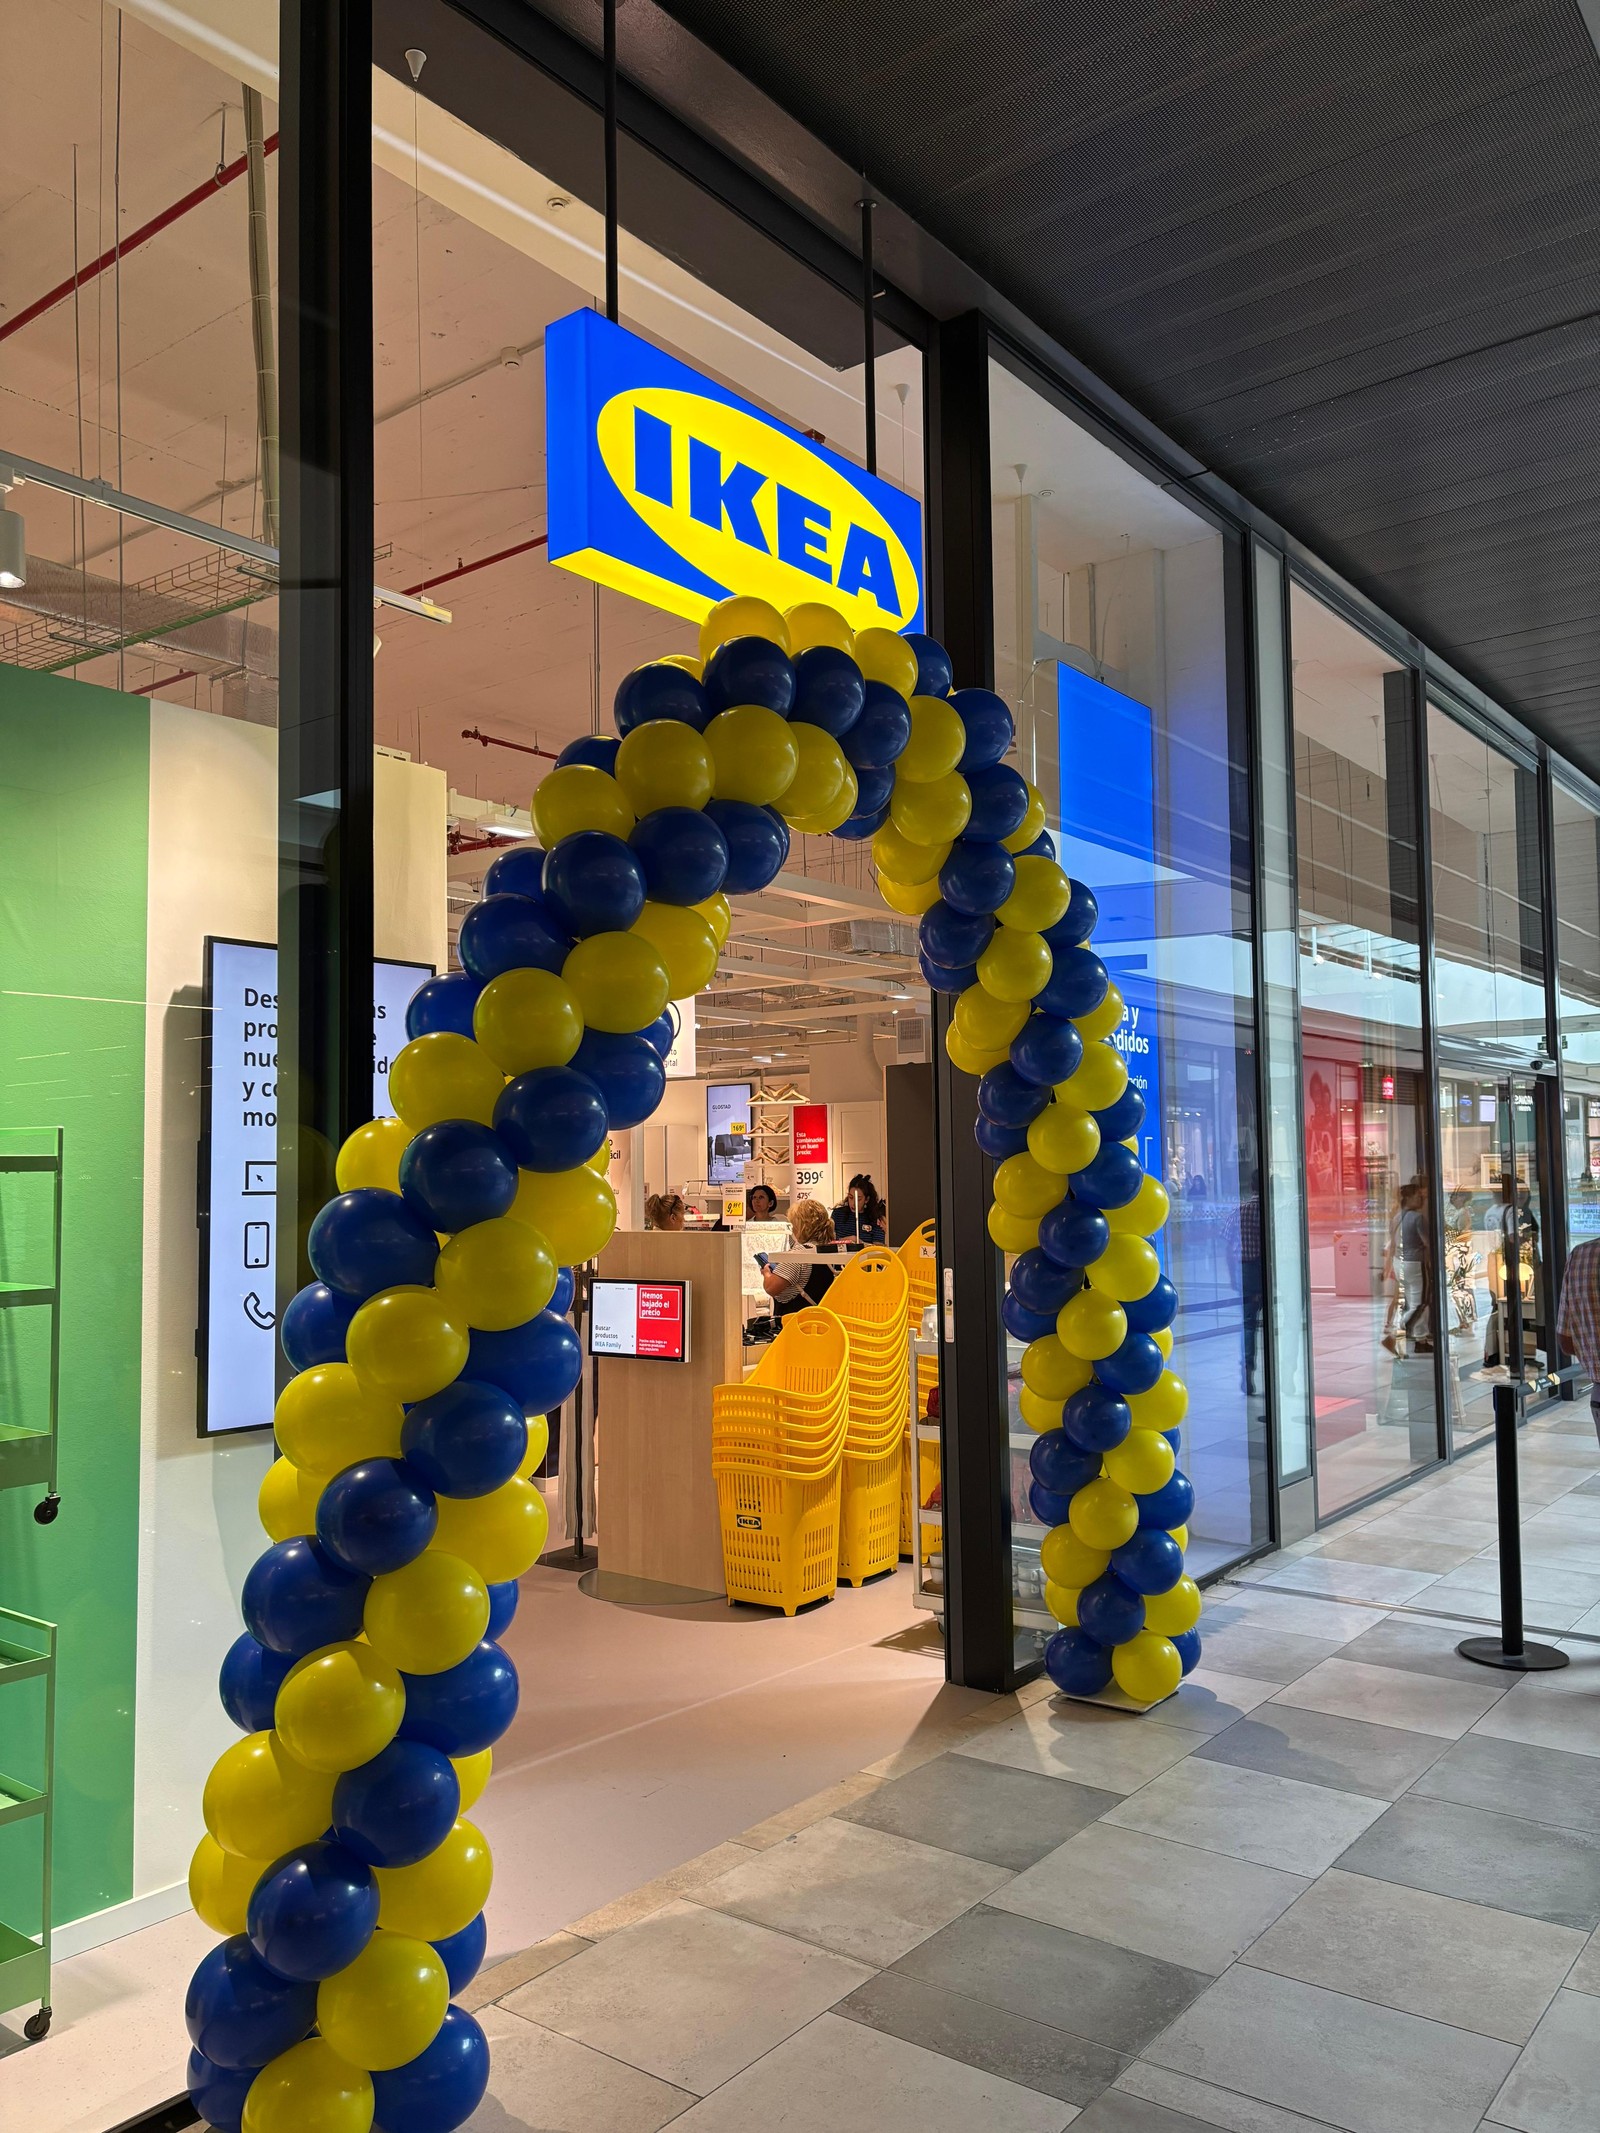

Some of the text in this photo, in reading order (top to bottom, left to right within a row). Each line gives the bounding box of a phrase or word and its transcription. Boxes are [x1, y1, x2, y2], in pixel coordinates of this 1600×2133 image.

[634, 405, 903, 618] IKEA
[1131, 1006, 1139, 1029] y
[243, 1081, 255, 1101] y
[642, 1301, 662, 1309] bajado
[739, 1518, 760, 1526] IKEA
